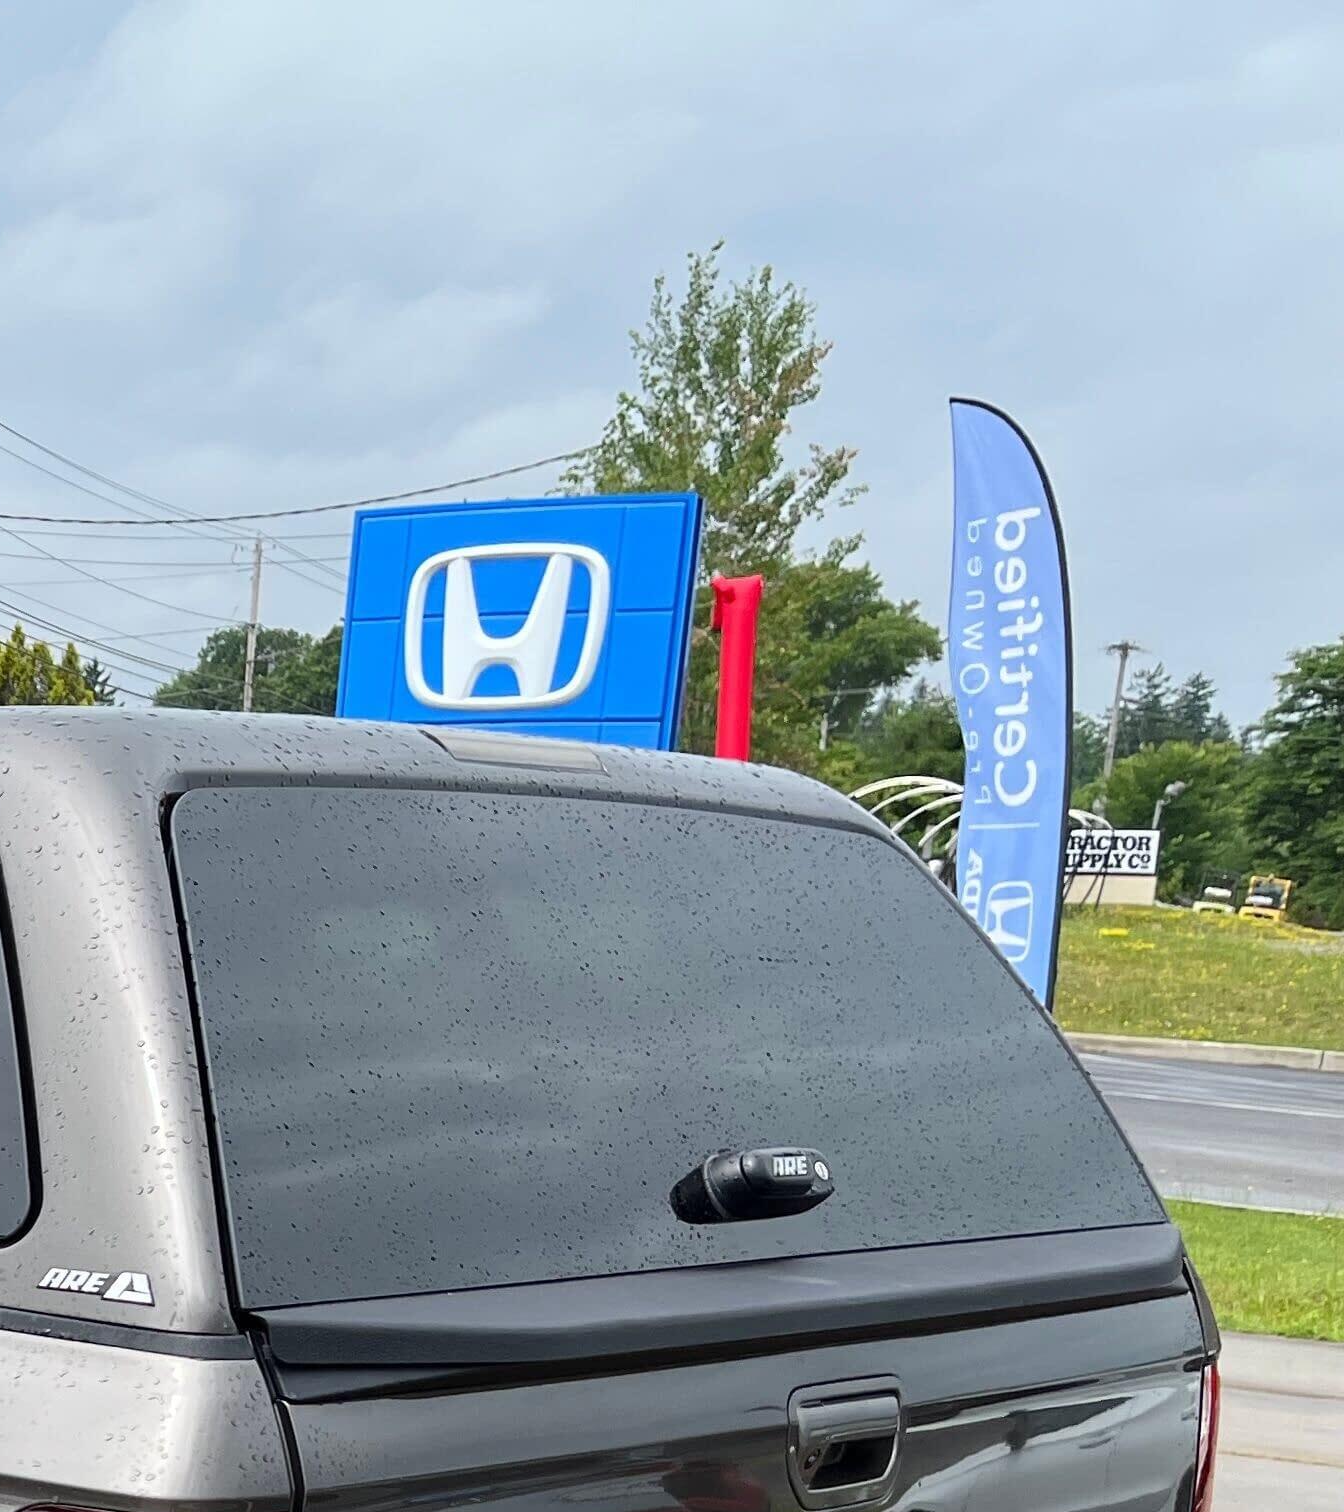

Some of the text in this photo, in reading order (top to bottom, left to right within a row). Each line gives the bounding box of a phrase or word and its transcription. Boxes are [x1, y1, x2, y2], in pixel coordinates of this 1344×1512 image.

[1069, 835, 1152, 851] RACTOR
[1064, 853, 1127, 869] UPPLY
[772, 1155, 809, 1177] ARE
[37, 1267, 110, 1293] ARE
